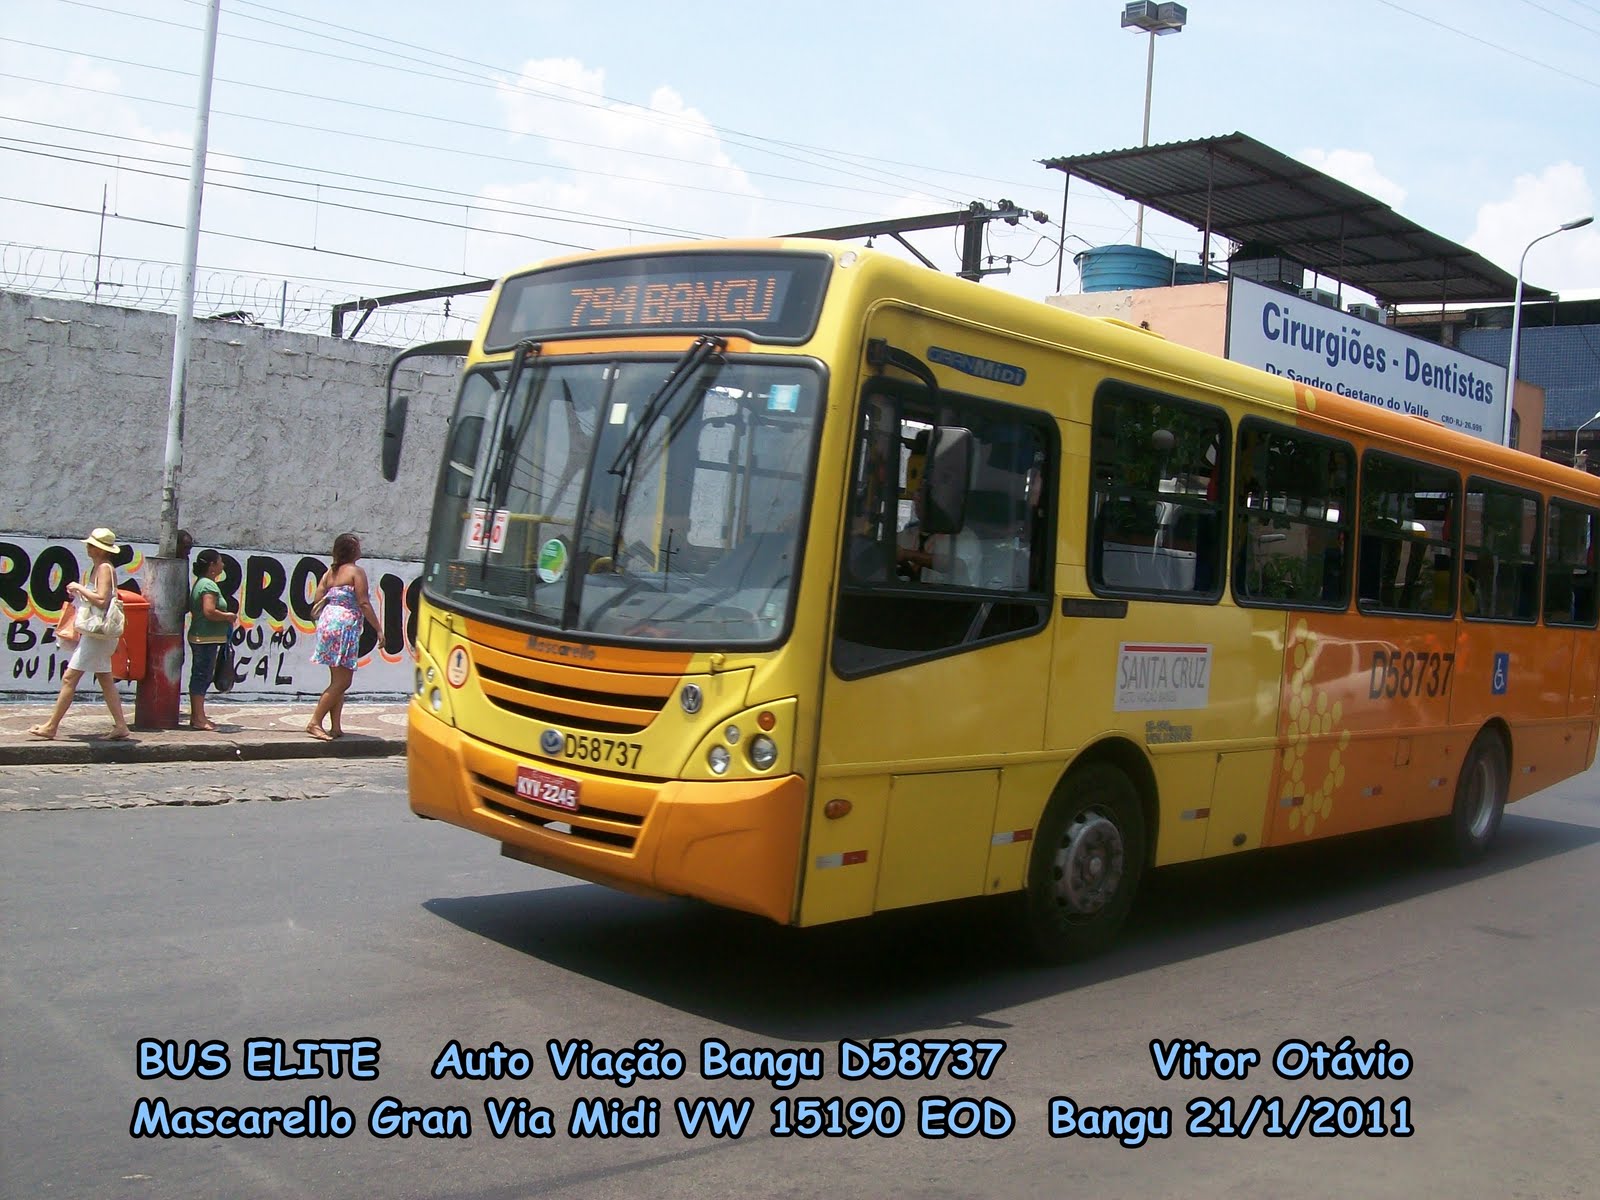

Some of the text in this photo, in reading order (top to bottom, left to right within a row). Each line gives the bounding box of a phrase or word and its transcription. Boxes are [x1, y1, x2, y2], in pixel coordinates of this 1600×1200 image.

[571, 278, 777, 327] 794 BANGU
[1262, 301, 1386, 373] Cirurgiões
[1405, 347, 1494, 405] Dentistas
[1287, 369, 1332, 392] Sandro
[1336, 382, 1384, 406] Caetano
[1387, 397, 1401, 410] do
[1403, 401, 1430, 418] Valle
[1120, 655, 1207, 690] SANTA CRUZ
[1369, 651, 1455, 699] D58737
[564, 733, 643, 770] D58737
